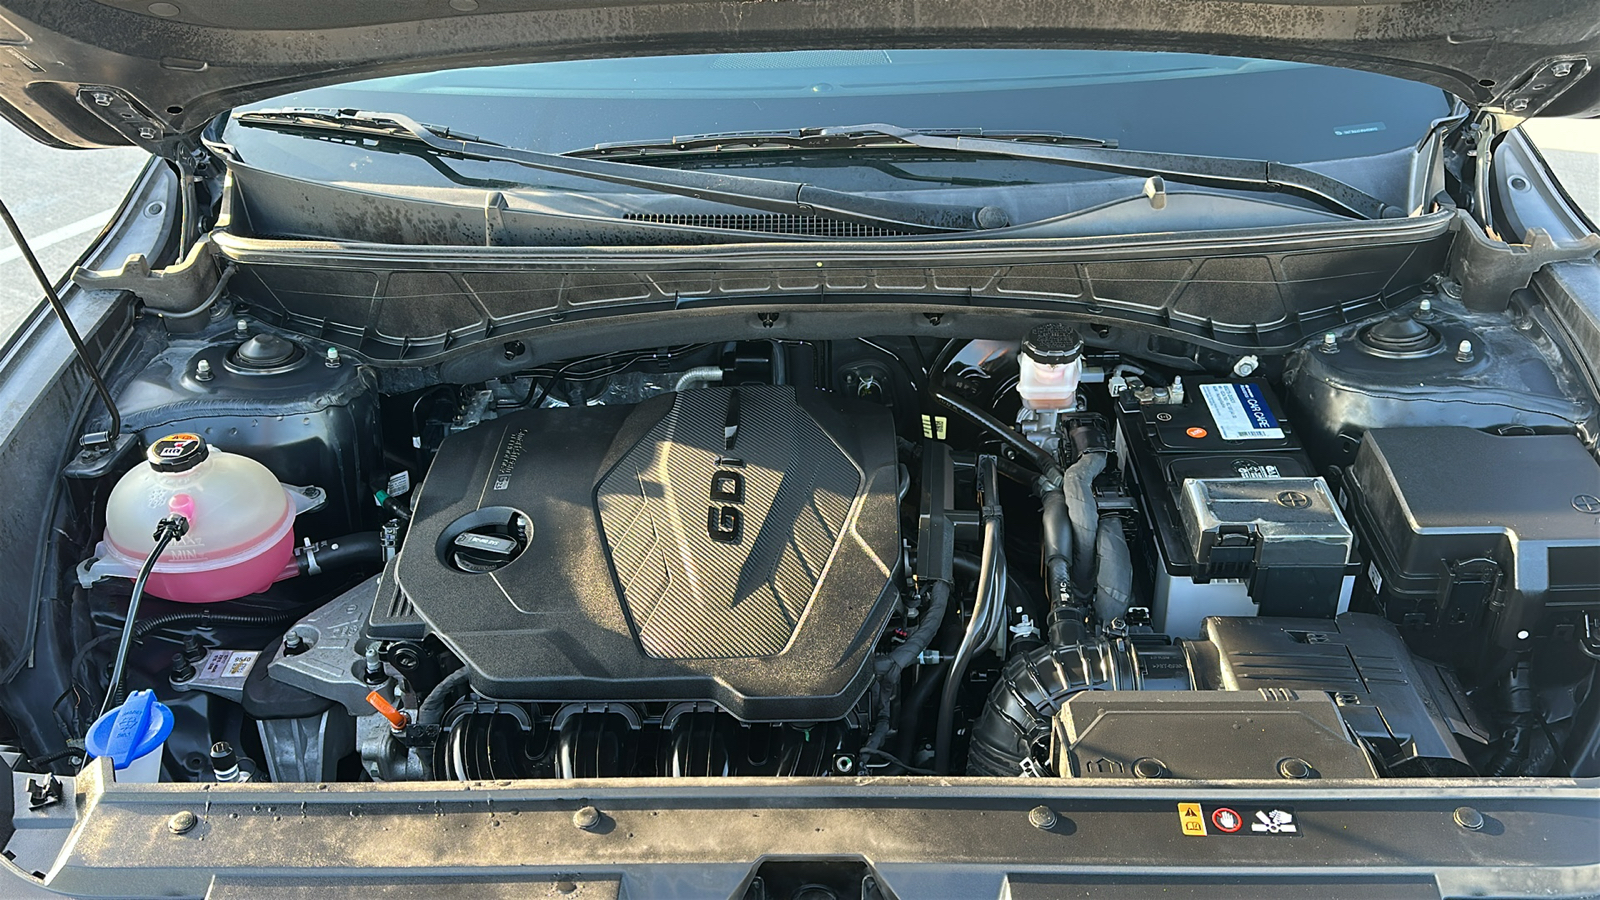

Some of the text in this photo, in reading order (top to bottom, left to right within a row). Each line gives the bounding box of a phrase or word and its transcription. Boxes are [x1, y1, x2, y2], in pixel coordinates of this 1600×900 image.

[1247, 399, 1261, 411] CAR
[1254, 412, 1270, 428] CARE
[171, 549, 196, 560] MIN
